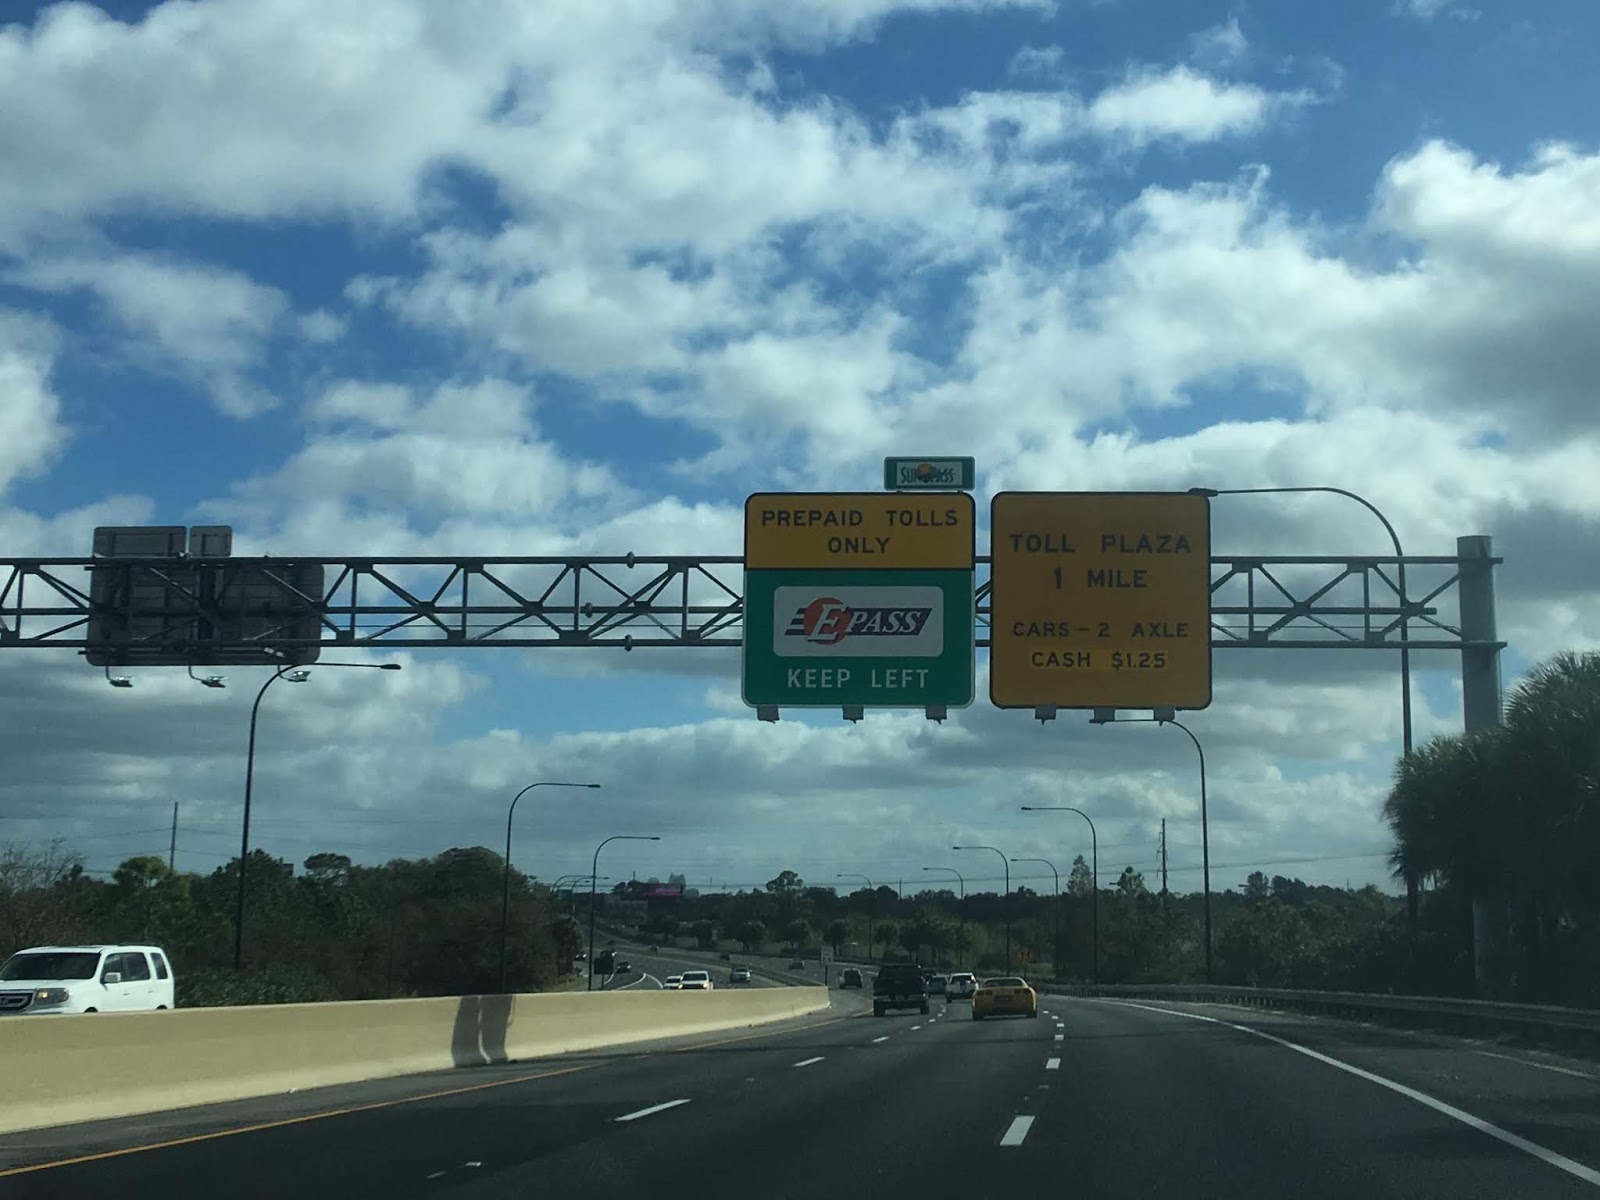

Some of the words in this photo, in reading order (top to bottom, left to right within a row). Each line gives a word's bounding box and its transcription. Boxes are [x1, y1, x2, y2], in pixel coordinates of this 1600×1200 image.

[761, 510, 863, 526] PREPAID
[886, 510, 958, 526] TOLLS
[827, 537, 891, 553] ONLY
[1009, 534, 1076, 553] TOLL
[1101, 534, 1191, 553] PLAZA
[1053, 568, 1062, 589] 1
[1087, 570, 1148, 588] MILE
[1131, 622, 1188, 638] AXLE
[1031, 652, 1090, 667] CASH
[1112, 651, 1166, 669] $1.25
[787, 669, 851, 688] KEEP
[871, 669, 929, 688] LEFT
